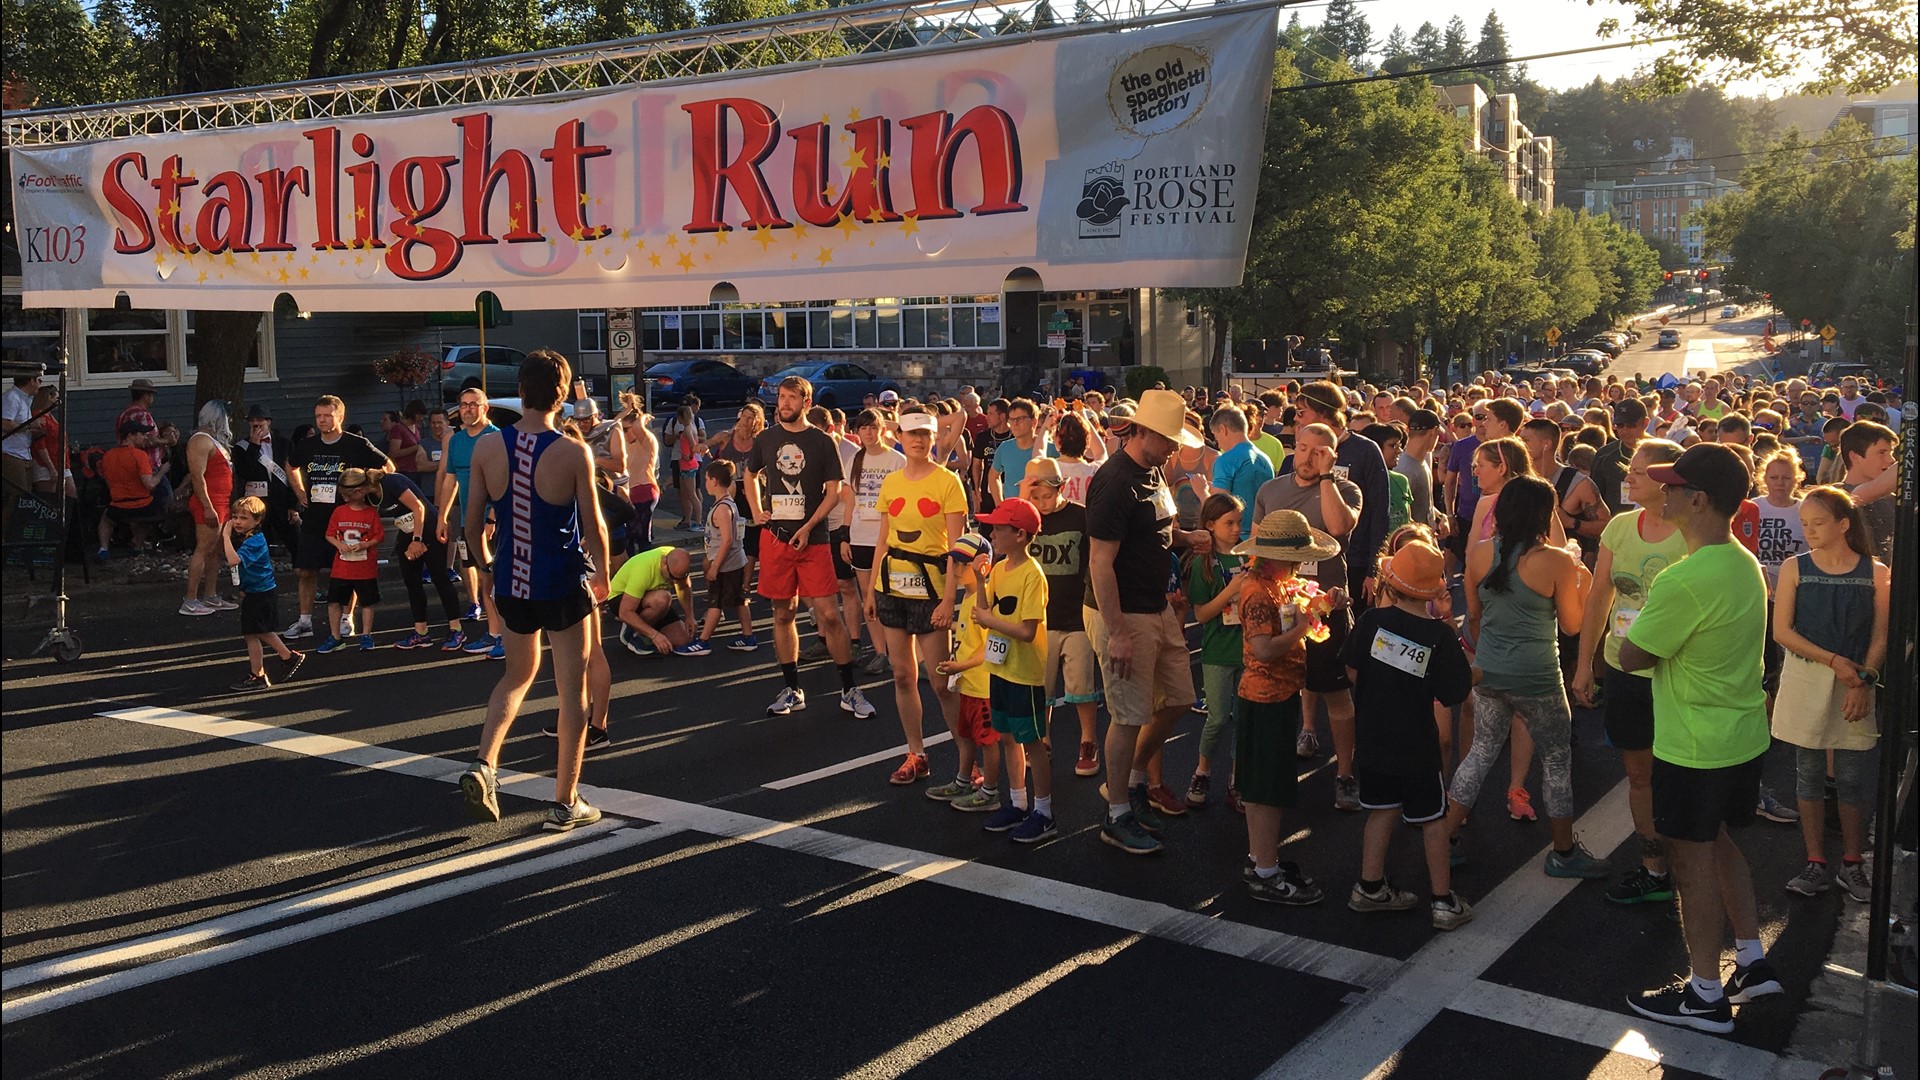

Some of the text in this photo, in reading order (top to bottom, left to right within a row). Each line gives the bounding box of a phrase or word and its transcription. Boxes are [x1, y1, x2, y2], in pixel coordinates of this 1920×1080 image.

[1120, 58, 1184, 92] the old
[1126, 67, 1205, 109] spaghetti
[1130, 92, 1190, 125] factory
[1133, 164, 1236, 181] PORTLAND
[101, 97, 1029, 281] Starlight Run
[1131, 179, 1235, 210] ROSE
[1130, 211, 1236, 226] FESTIVAL
[25, 225, 87, 265] K103
[618, 335, 628, 345] P
[307, 462, 345, 475] Starlight
[1904, 427, 1917, 500] GRANITE
[784, 497, 805, 507] 1792
[512, 431, 538, 600] SPUDDERS
[1758, 528, 1793, 540] AIR
[1030, 542, 1073, 565] PDX
[1758, 539, 1803, 552] ON'T
[1758, 550, 1795, 561] ARE
[988, 639, 1007, 654] 750
[1399, 643, 1426, 664] 748
